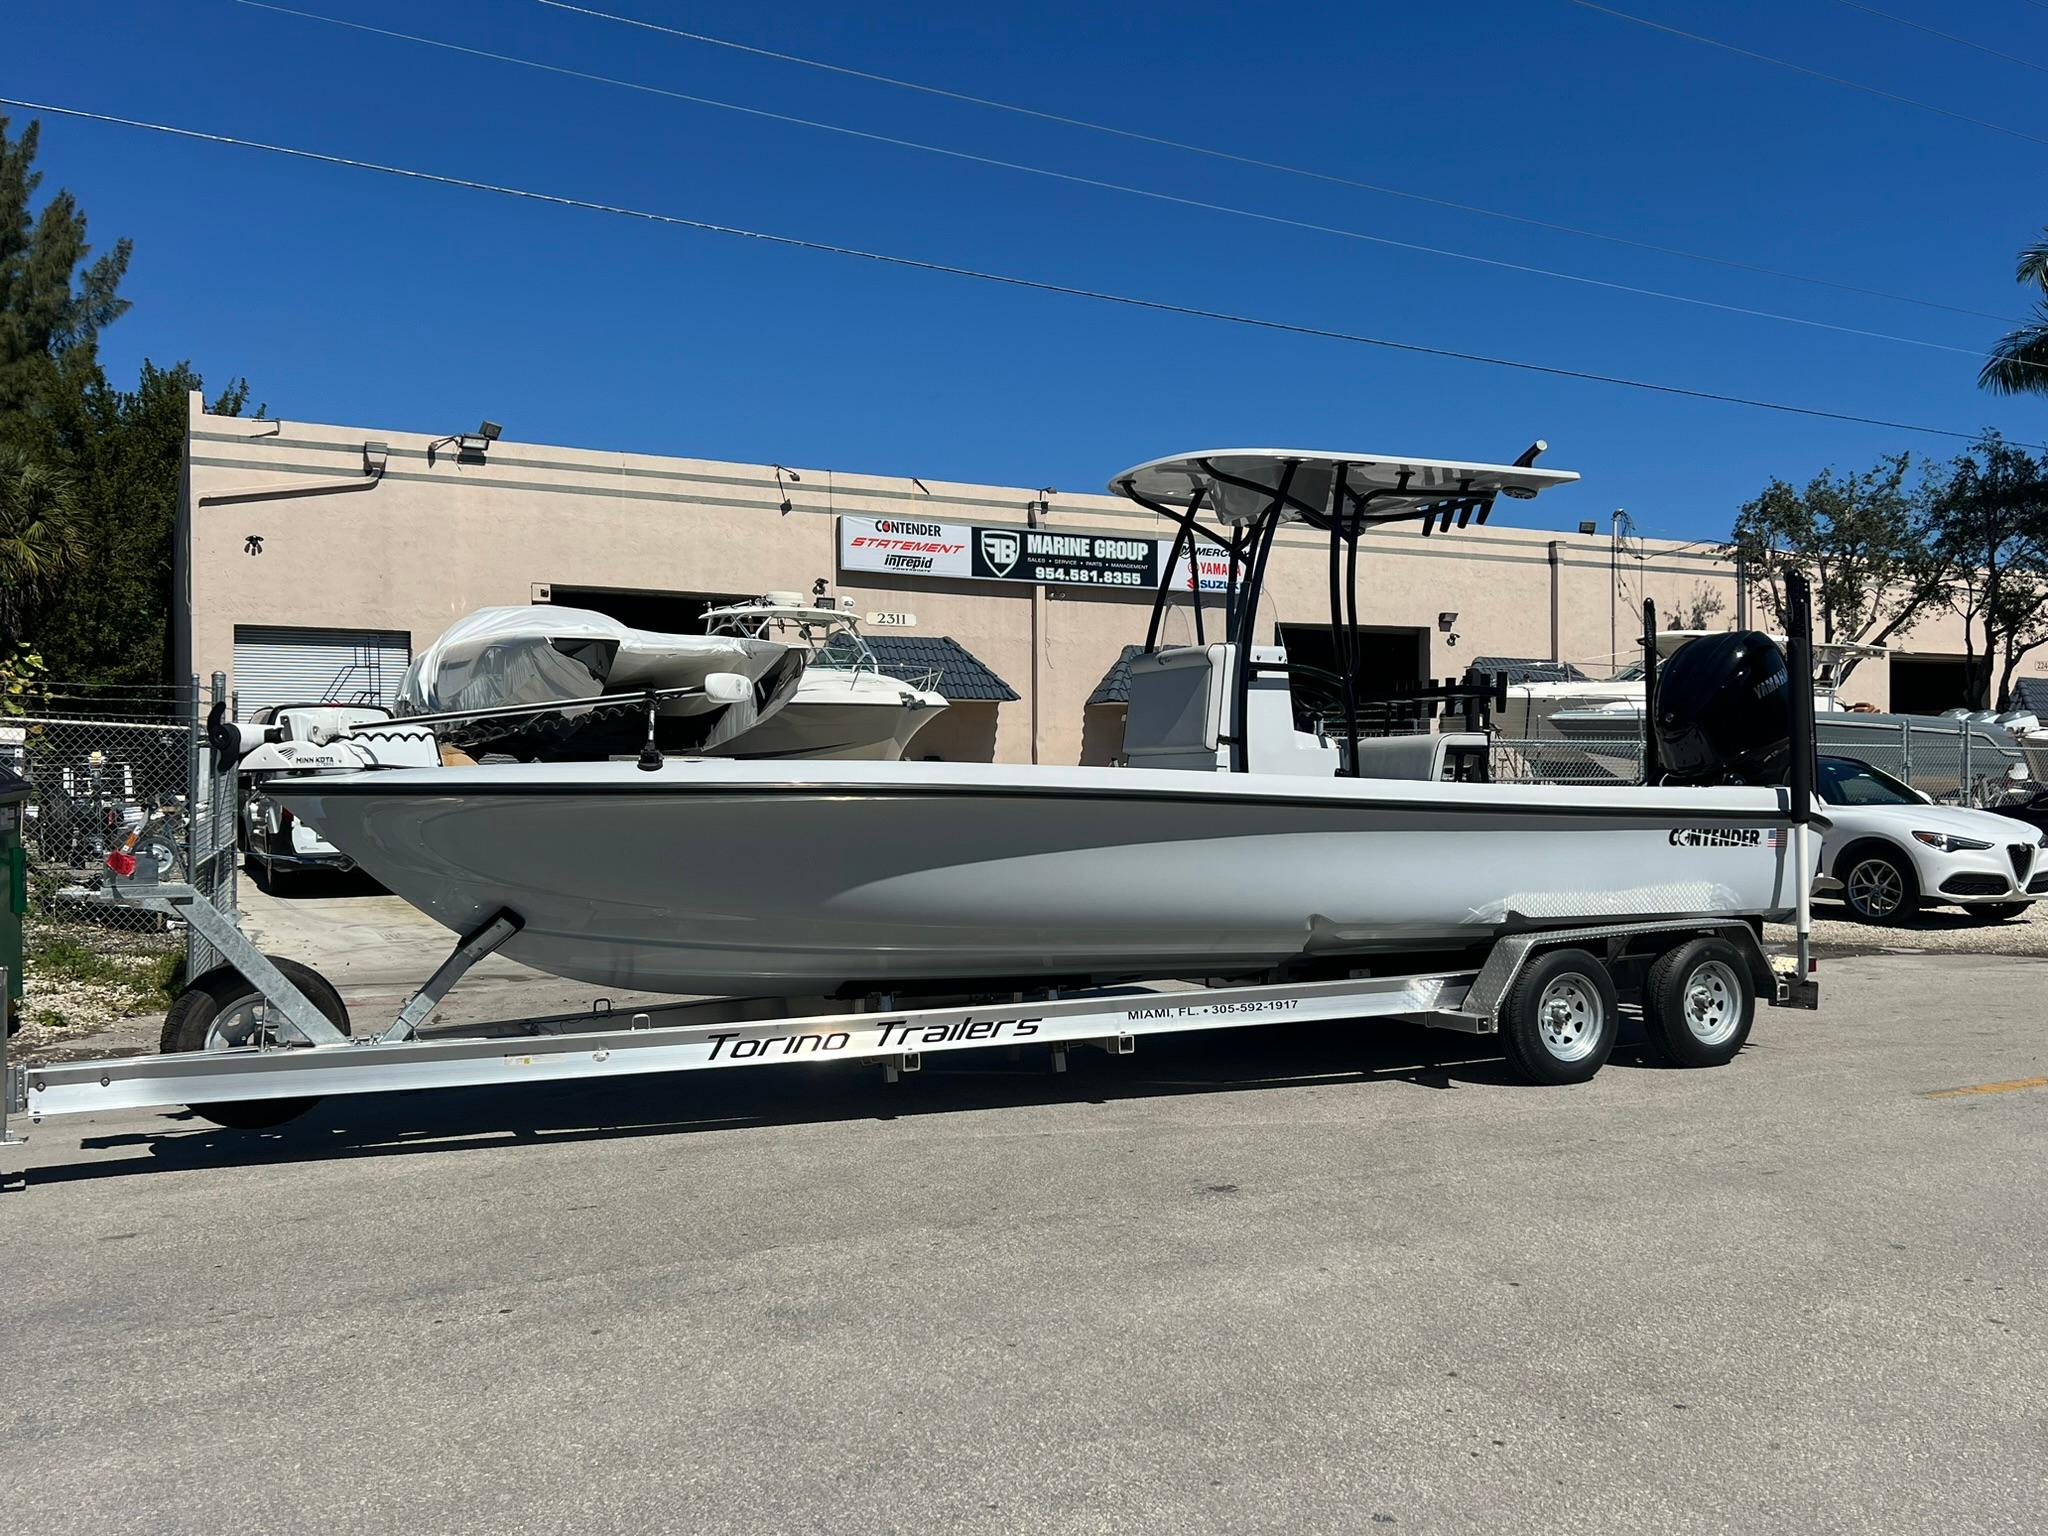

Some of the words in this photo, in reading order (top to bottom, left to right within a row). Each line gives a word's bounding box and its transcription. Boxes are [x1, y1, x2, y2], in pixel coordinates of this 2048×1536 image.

[875, 520, 942, 537] CONTENDER
[851, 537, 965, 554] STATEMENT
[1027, 534, 1091, 558] MARINE
[1094, 539, 1149, 561] GROUP
[1195, 547, 1252, 559] MERC
[1027, 556, 1046, 564] SALES
[1110, 562, 1149, 570] MANAGEMENT
[1035, 566, 1142, 585] 954.581.8355
[877, 612, 906, 625] 2311
[1753, 667, 1788, 700] YAMAH
[1669, 828, 1760, 847] CONTENDER
[1127, 1007, 1174, 1020] MIAMI,
[1178, 1007, 1200, 1016] FL.
[1211, 1000, 1298, 1015] 305-592-1917
[707, 1032, 851, 1061] Torino
[876, 1016, 1043, 1047] Trailers
